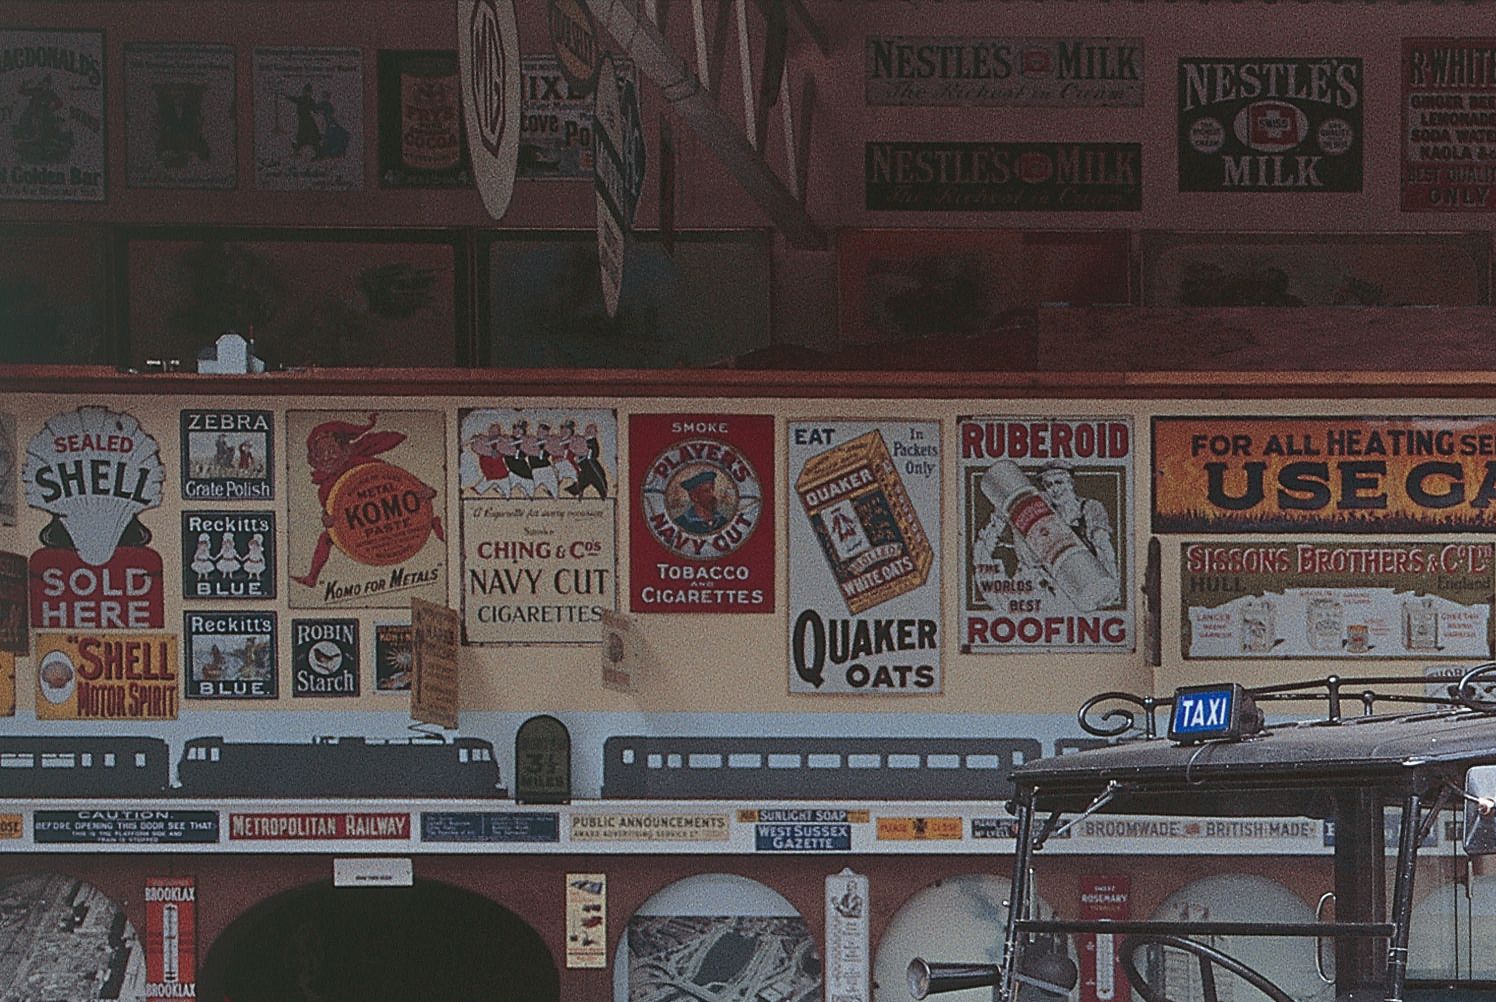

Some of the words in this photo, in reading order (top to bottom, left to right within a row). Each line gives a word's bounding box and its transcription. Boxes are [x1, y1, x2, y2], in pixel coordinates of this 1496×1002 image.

[1056, 42, 1139, 80] MILK
[1421, 113, 1496, 125] LEMONADE
[405, 132, 456, 148] COCOA
[1412, 130, 1451, 142] SODA
[1056, 146, 1135, 184] MILK
[1222, 156, 1324, 186] MILK
[1430, 188, 1489, 206] ONLY
[188, 415, 269, 430] ZEBRA
[672, 422, 728, 433] SMOKE
[54, 435, 133, 453] SEALED
[794, 429, 835, 445] EAT
[962, 423, 1129, 458] RUBEROID
[1192, 434, 1252, 457] FOR
[1262, 434, 1323, 456] ALL
[1327, 430, 1454, 456] HEATING
[893, 442, 938, 458] Packets
[654, 444, 751, 483] PLAYER'S
[906, 461, 934, 479] Only
[35, 460, 151, 505] SHELL
[186, 483, 224, 497] Grate
[226, 482, 270, 497] Polish
[805, 469, 874, 506] QUAKER
[1204, 461, 1387, 511] USE
[345, 490, 420, 529] KOMO
[189, 517, 269, 532] Reckitt's
[650, 514, 707, 554] NAVY
[711, 512, 754, 551] CUT
[477, 542, 551, 559] CHING
[1187, 545, 1289, 574] SISSONS
[1298, 545, 1423, 574] BROTHERS
[657, 563, 749, 580] TOBACCO
[42, 568, 152, 597] SOLD
[364, 580, 386, 593] FOR
[470, 570, 541, 595] NAVY
[554, 569, 609, 595] CUT
[1189, 577, 1247, 592] HULL
[1438, 576, 1489, 591] England
[642, 587, 763, 603] CIGARETTES
[42, 601, 151, 628] HERE
[478, 606, 602, 623] CIGARETTES
[191, 617, 271, 632] Reckitt's
[967, 618, 1126, 643] ROOFING
[298, 626, 354, 643] ROBIN
[793, 609, 937, 689] QUAKER
[297, 672, 354, 692] Starch
[846, 665, 934, 688] OATS
[77, 682, 126, 717] MOTOR
[128, 683, 176, 717] SPIRIT
[1181, 698, 1230, 728] TAXI
[573, 818, 615, 828] PUBLIC
[619, 817, 725, 828] ANNOUNCEMENTS
[760, 812, 814, 822] SUNLIGHT
[817, 811, 847, 821] SOAP
[232, 815, 337, 837] METROPOLITAN
[345, 815, 409, 838] RAILWAY
[757, 826, 794, 837] WEST
[794, 826, 848, 837] SUSSEX
[1086, 821, 1176, 837] BROOMWADE
[772, 838, 833, 849] GAZETTE
[145, 887, 195, 901] BROOKLAX
[147, 983, 196, 997] BROOKLAX
